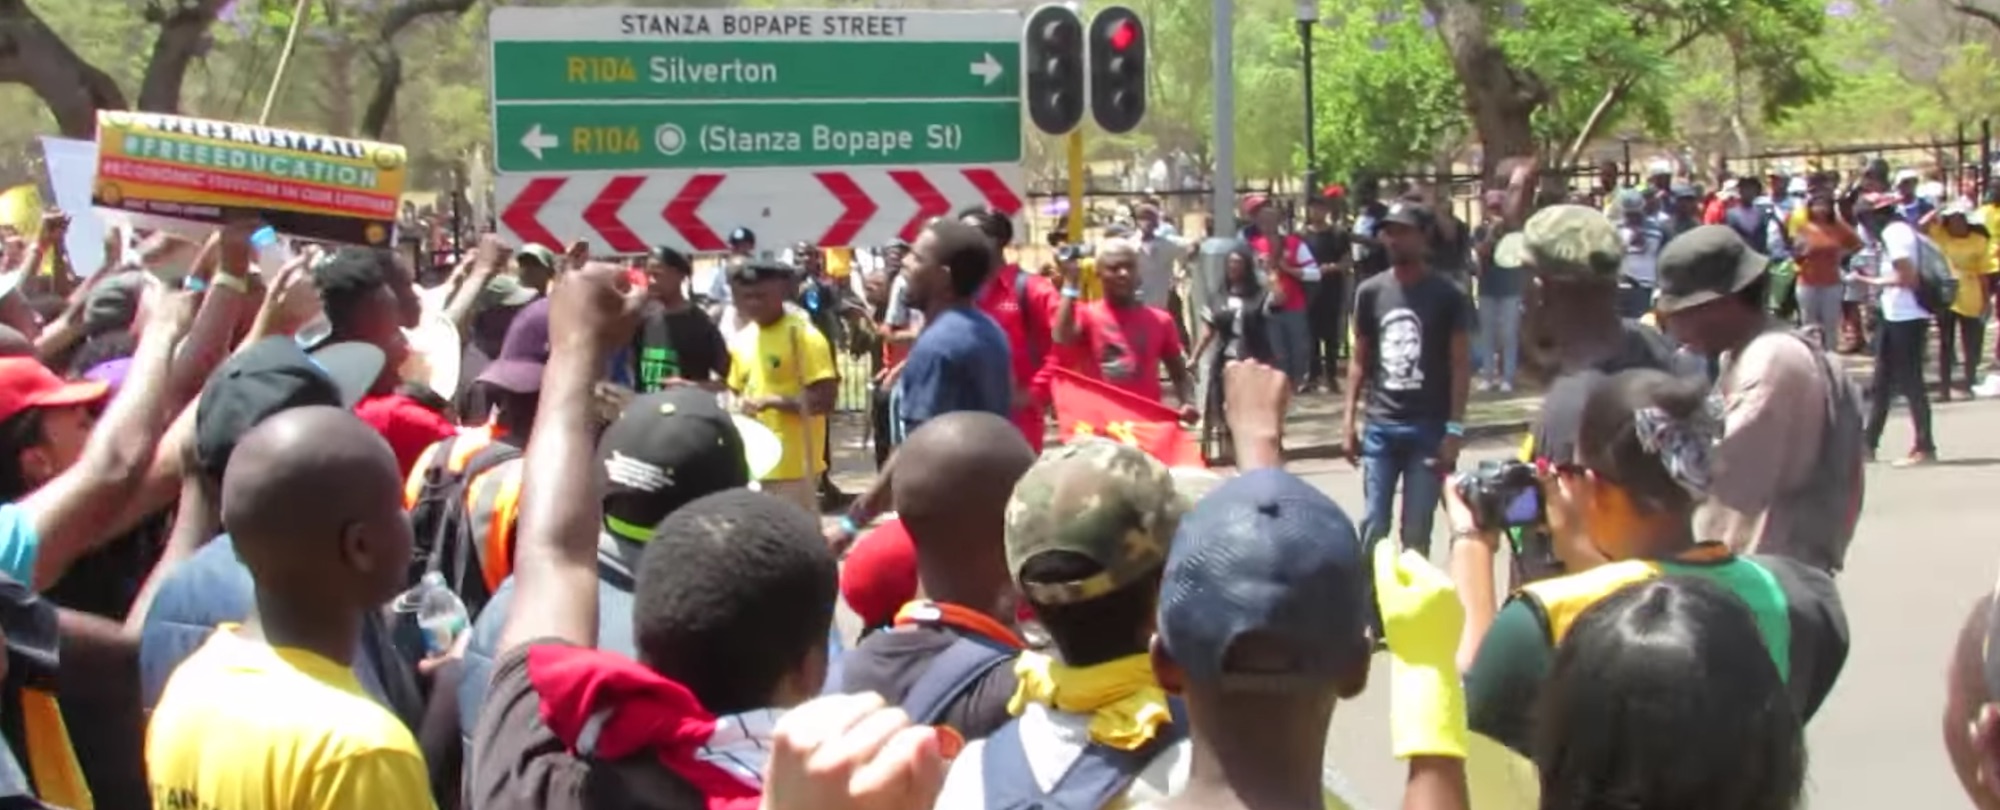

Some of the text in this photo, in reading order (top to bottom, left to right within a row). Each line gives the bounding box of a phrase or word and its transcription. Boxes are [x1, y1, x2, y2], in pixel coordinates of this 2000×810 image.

[620, 14, 908, 36] STANZA BOPAPE STREET
[567, 56, 778, 84] R104 Silverton
[572, 123, 962, 156] R104 (Stanza Bopape St)
